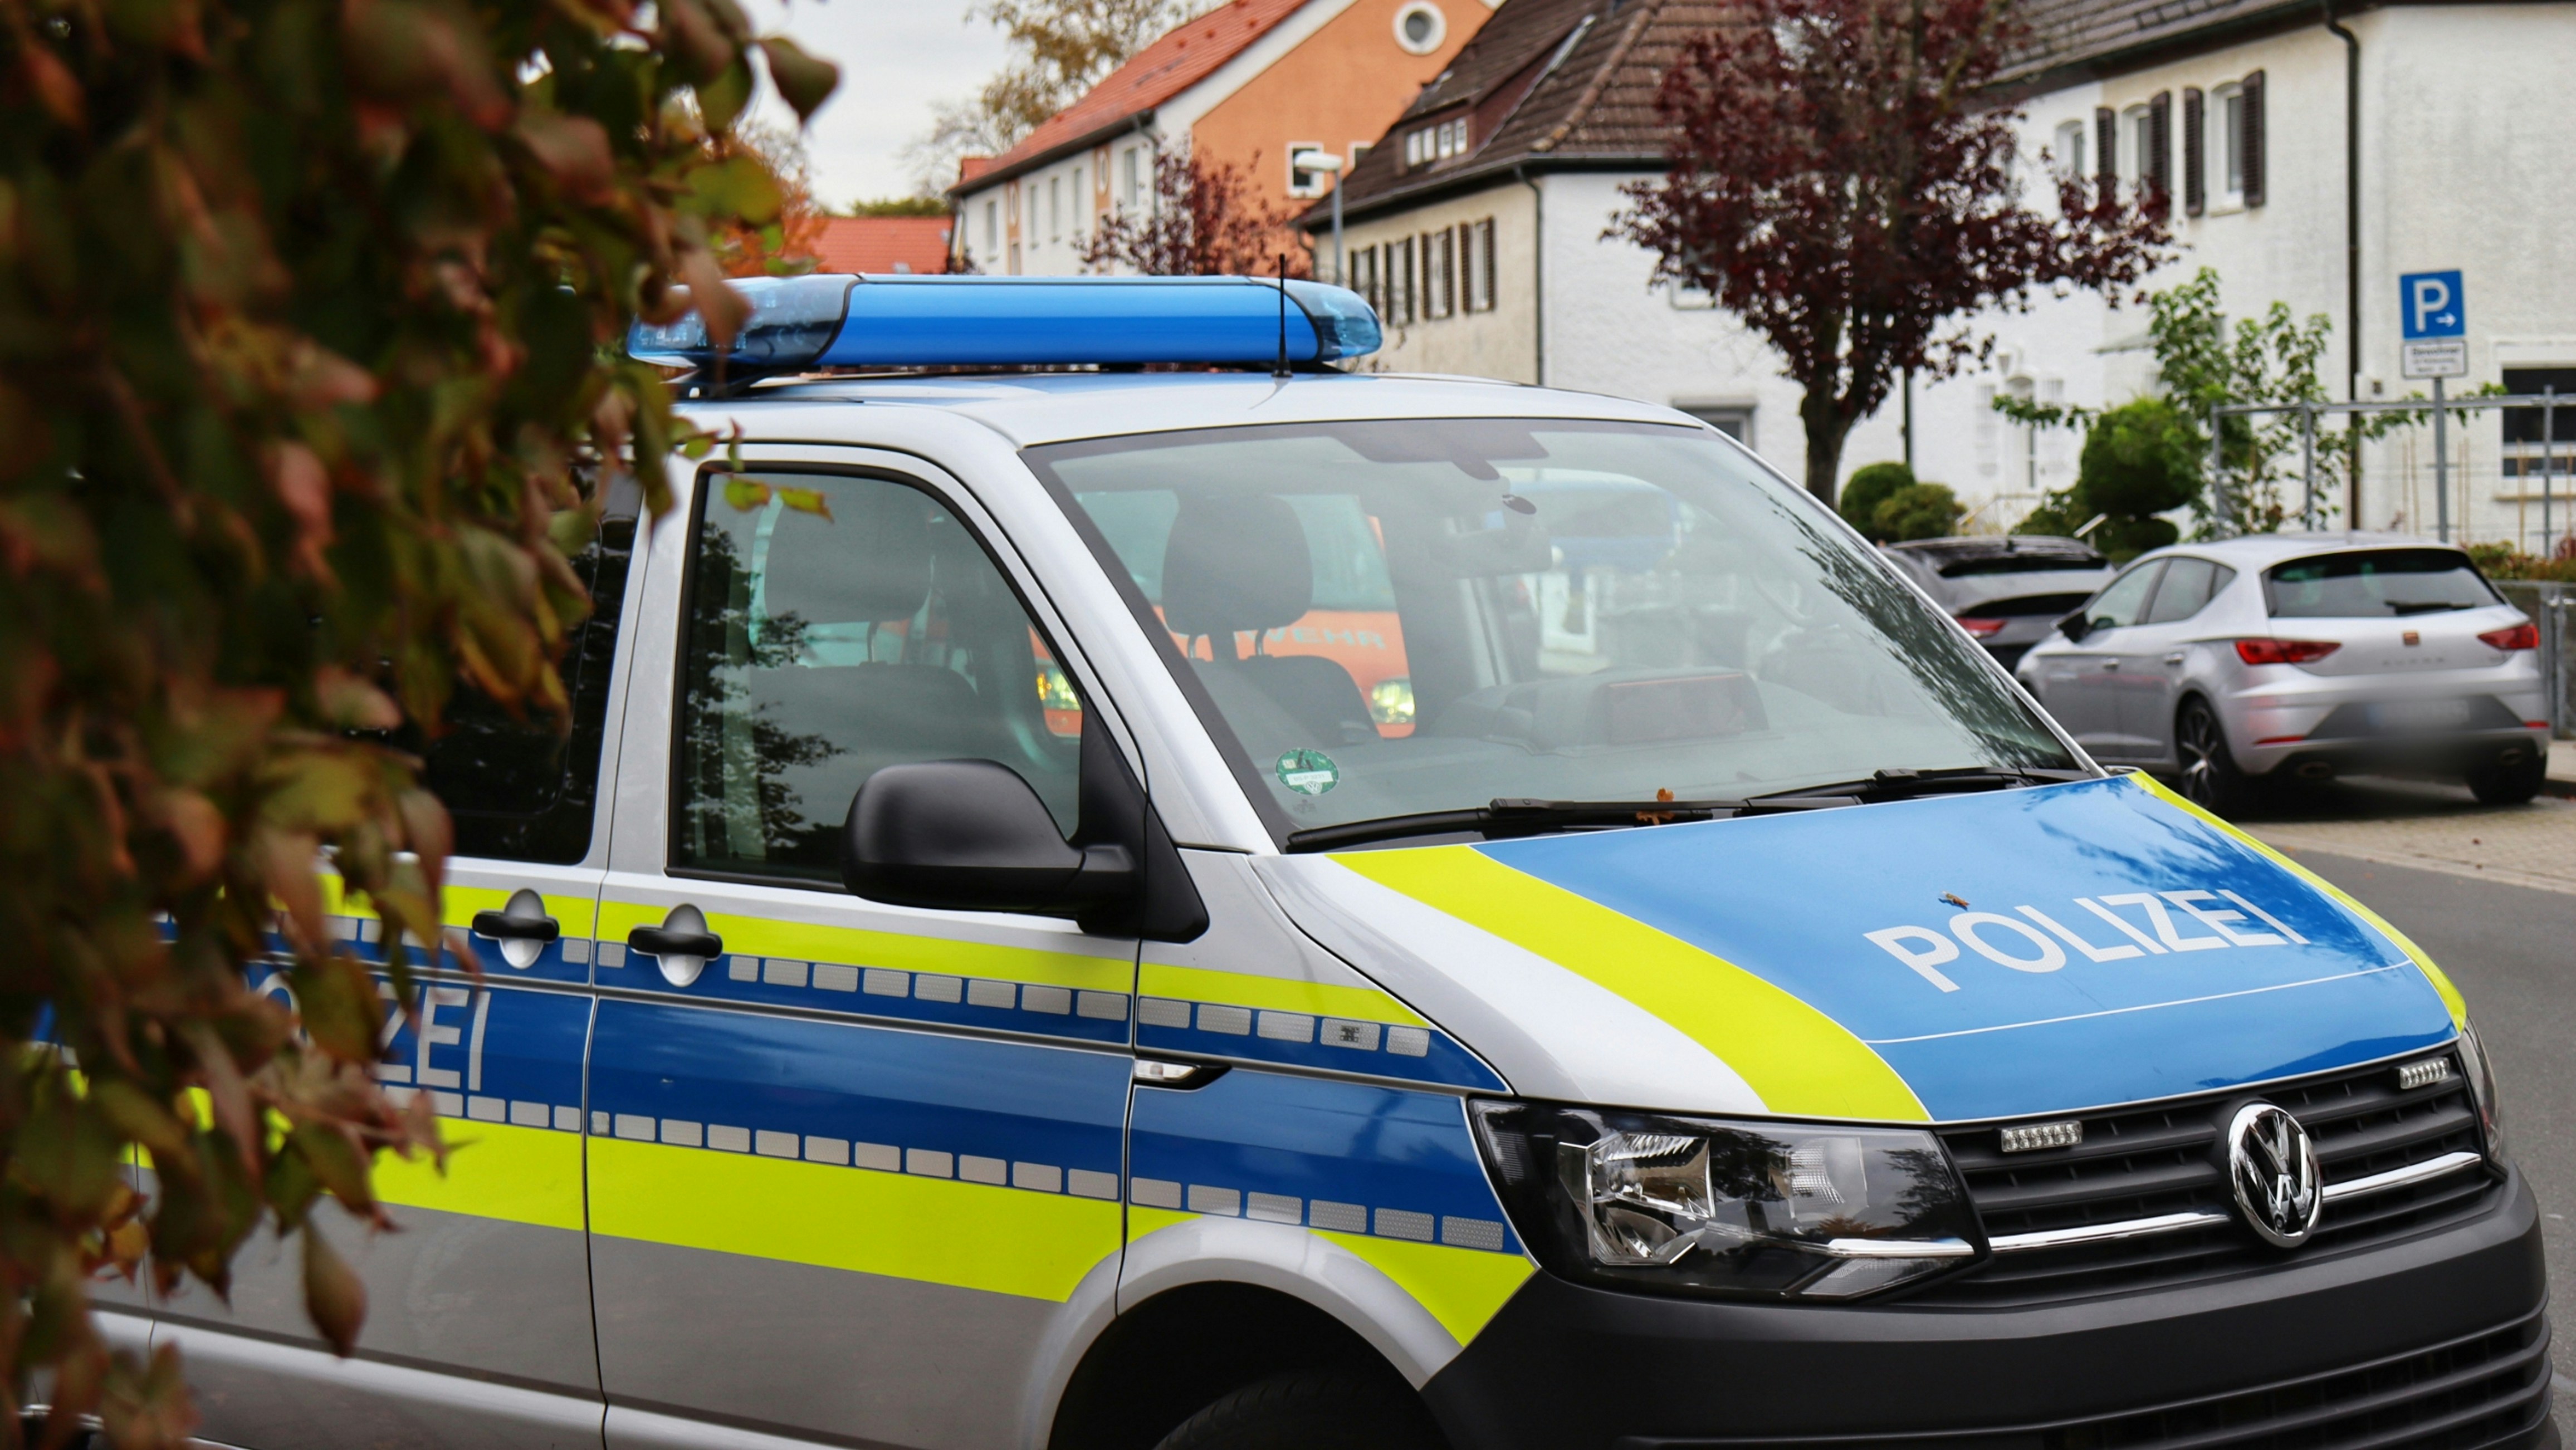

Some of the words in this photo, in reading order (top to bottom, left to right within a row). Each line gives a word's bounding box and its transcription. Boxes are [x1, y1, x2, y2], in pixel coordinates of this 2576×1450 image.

[2413, 278, 2450, 332] P
[1297, 751, 1314, 771] 4
[1862, 889, 2311, 993] POLIZEI
